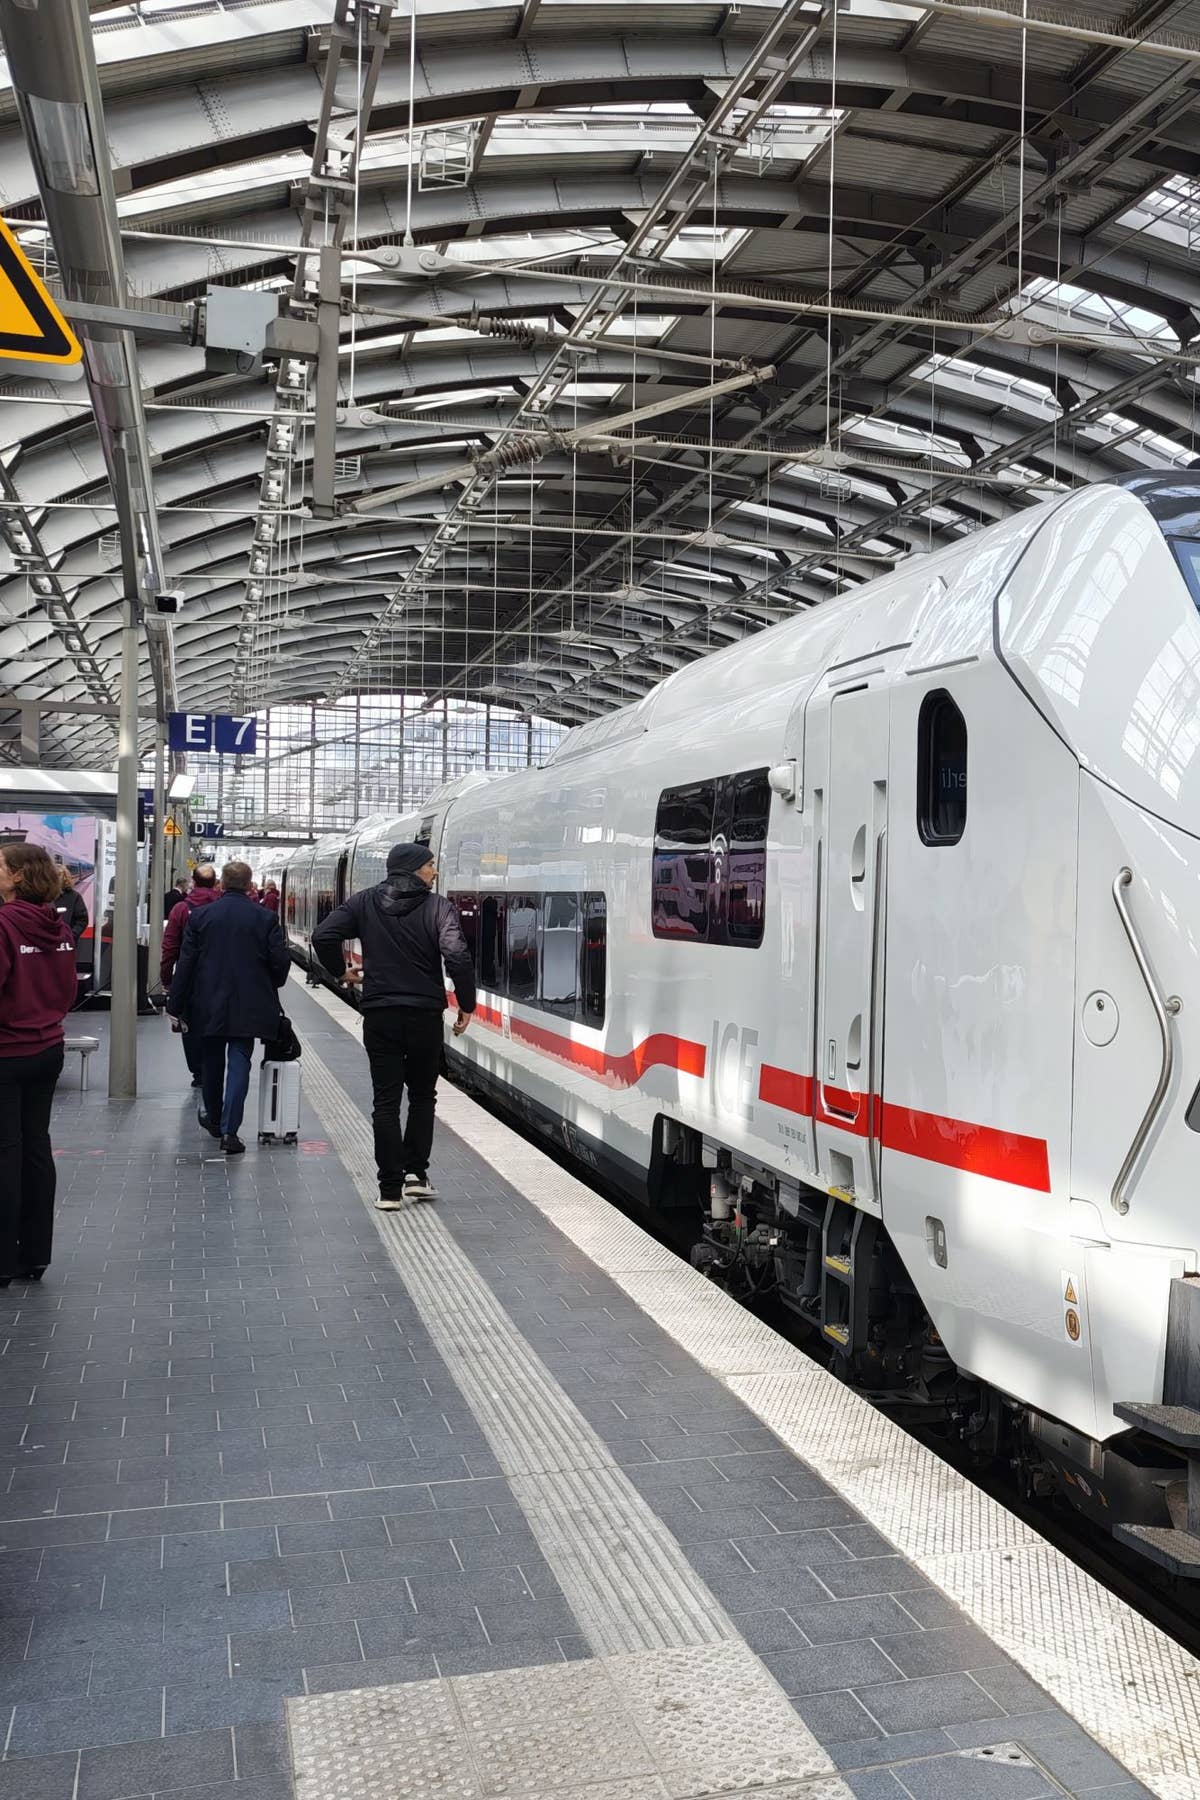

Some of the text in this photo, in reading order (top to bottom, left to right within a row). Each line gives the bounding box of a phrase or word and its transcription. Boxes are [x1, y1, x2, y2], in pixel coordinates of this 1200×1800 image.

[185, 714, 252, 746] E 7
[194, 822, 223, 834] D 7
[709, 1019, 759, 1122] ICE
